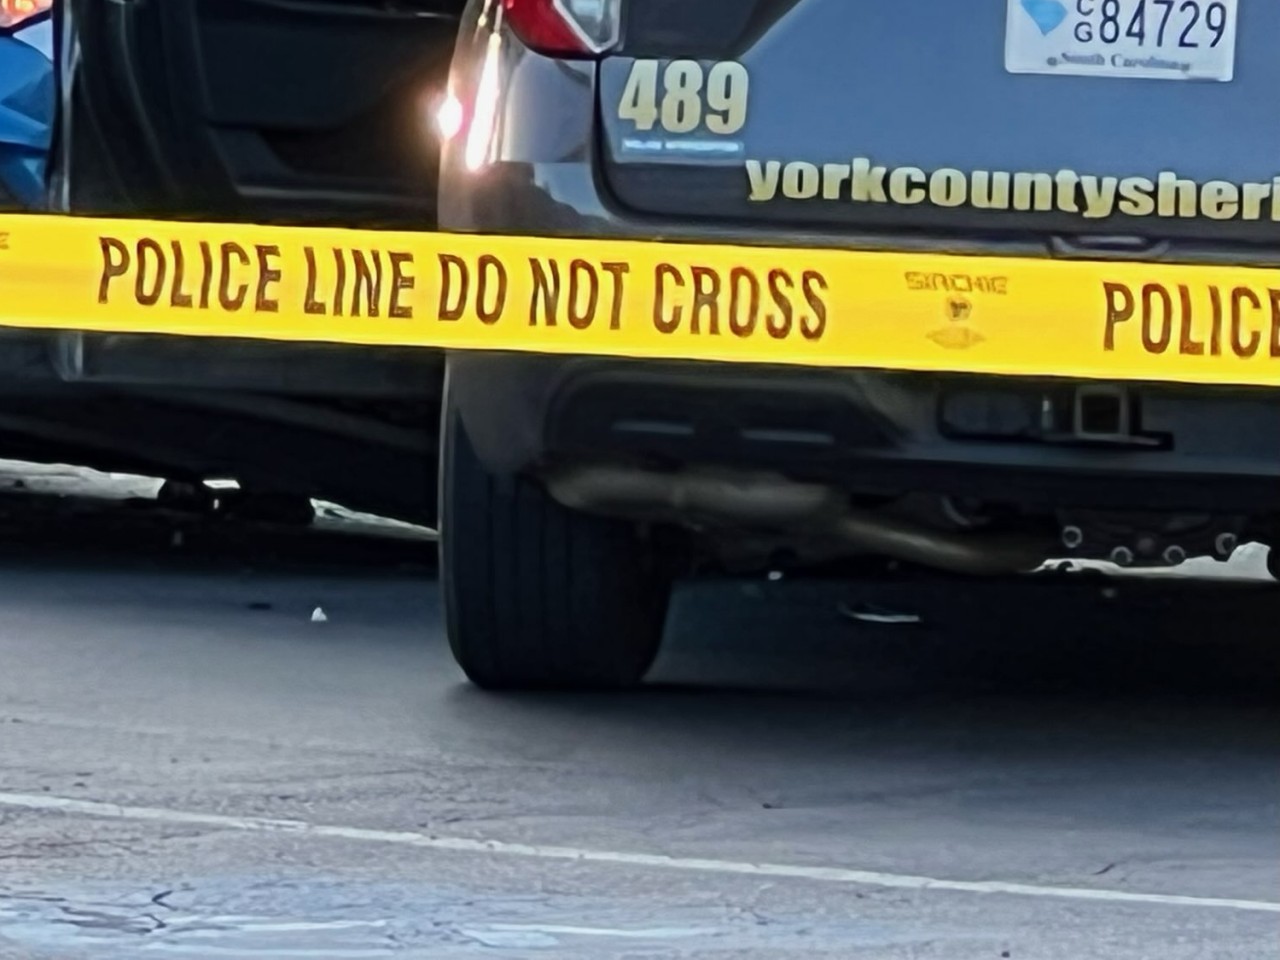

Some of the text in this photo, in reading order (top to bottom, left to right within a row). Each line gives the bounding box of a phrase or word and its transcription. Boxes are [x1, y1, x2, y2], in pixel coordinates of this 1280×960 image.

[618, 59, 749, 135] 489
[98, 236, 829, 341] POLICE LINE DO NOT CROSS
